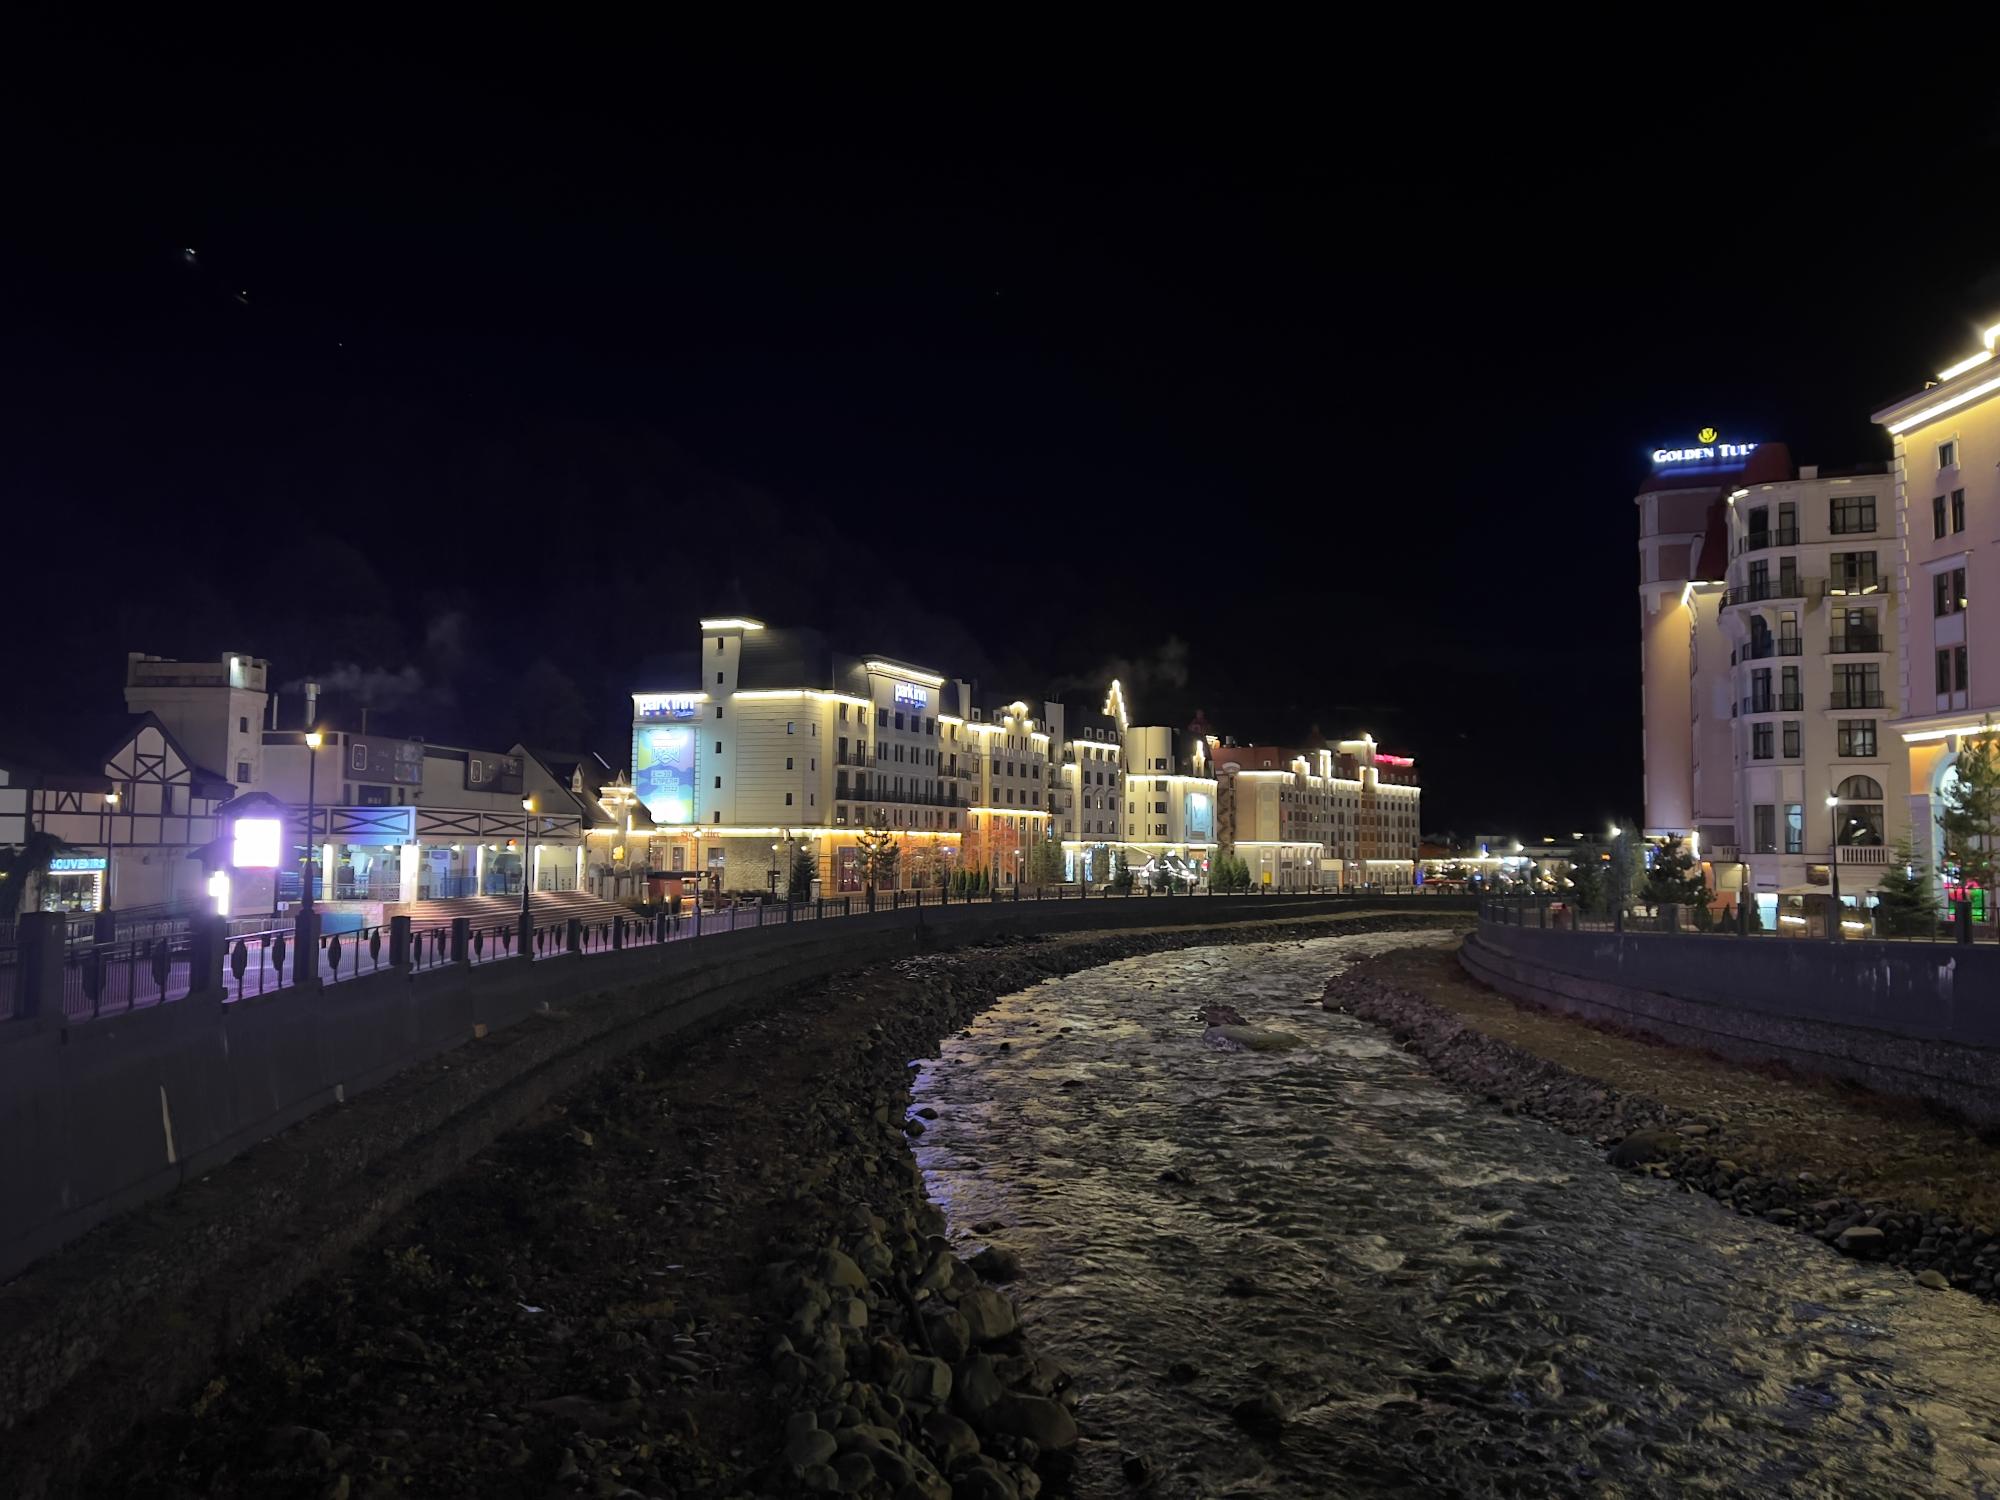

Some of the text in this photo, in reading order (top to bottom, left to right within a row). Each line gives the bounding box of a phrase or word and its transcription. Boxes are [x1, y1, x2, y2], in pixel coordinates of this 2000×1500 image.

[1653, 443, 1759, 463] GOLDEN TUL
[894, 683, 927, 702] park inn
[639, 698, 671, 716] park
[50, 858, 106, 870] SOUVENIRS
